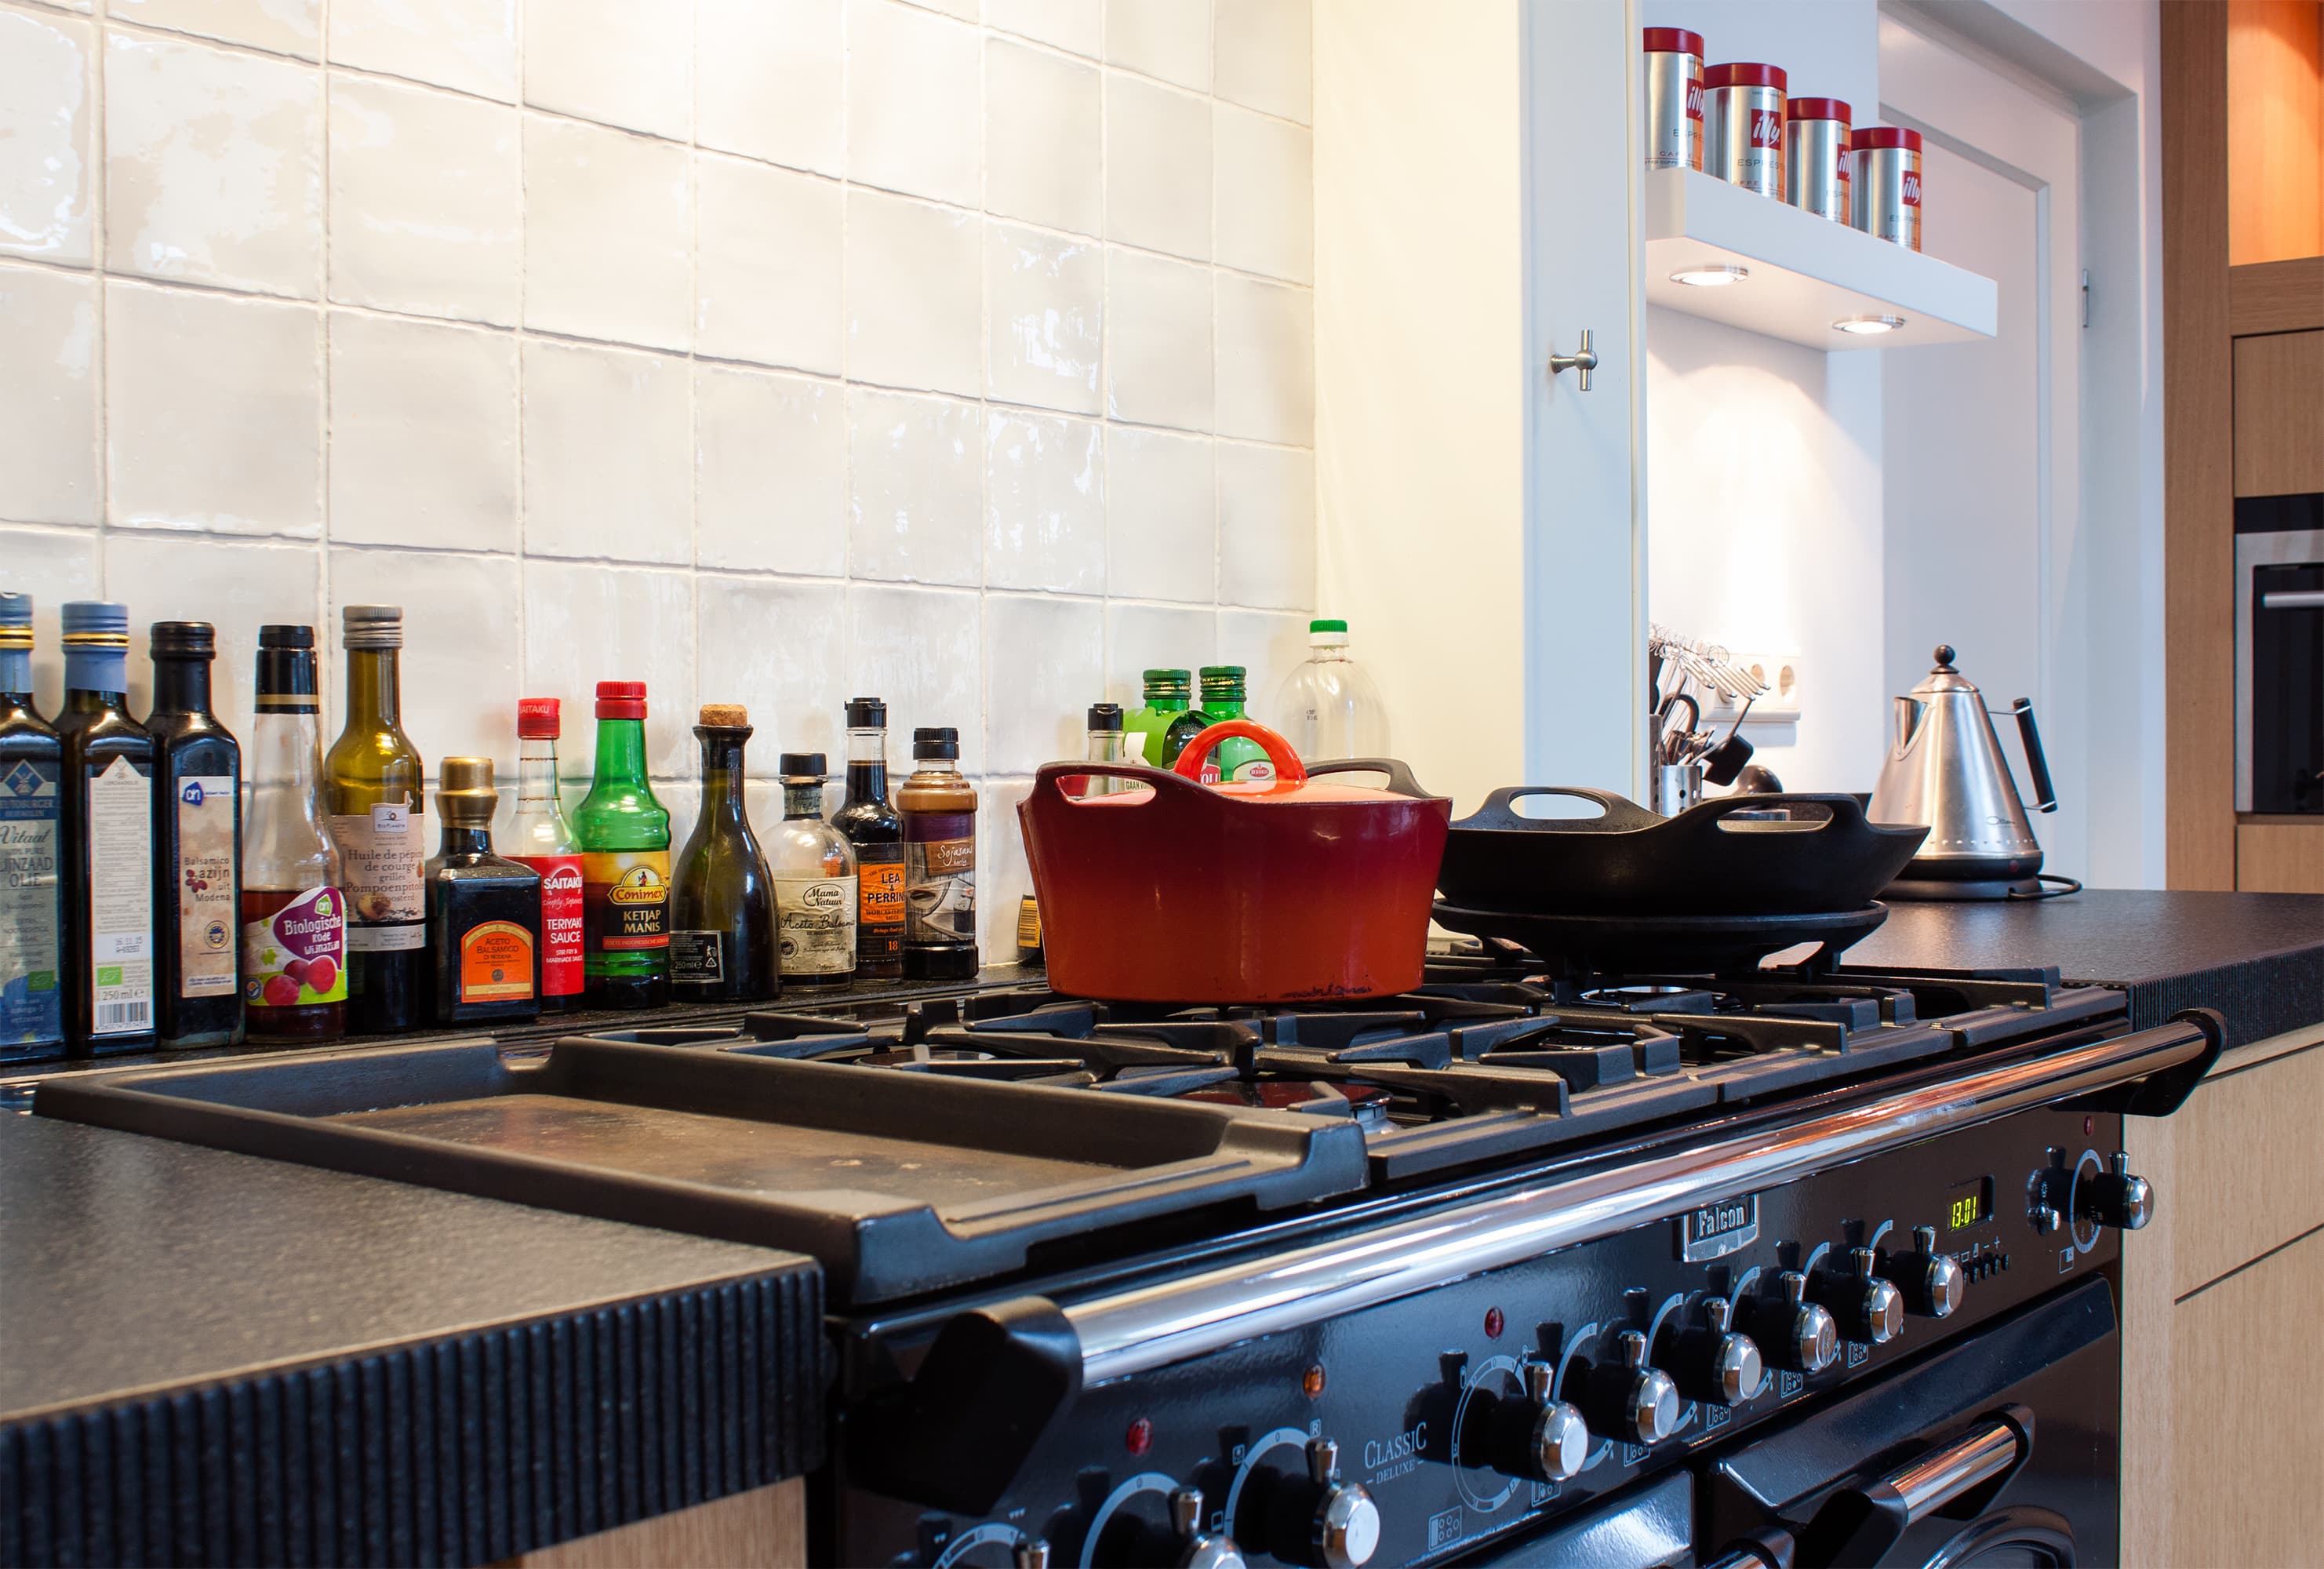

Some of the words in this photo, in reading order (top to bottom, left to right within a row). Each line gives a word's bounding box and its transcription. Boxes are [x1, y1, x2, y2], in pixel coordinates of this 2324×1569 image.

[1753, 115, 1780, 145] illy
[1902, 177, 1921, 205] illy
[1126, 781, 1140, 791] GAAN
[184, 857, 230, 866] Balsamico
[347, 849, 382, 861] Huile
[384, 849, 397, 860] de
[0, 856, 53, 874] IJNZAAD
[364, 861, 379, 872] de
[381, 862, 416, 874] courge
[9, 872, 42, 888] OLIE
[882, 872, 901, 884] LEA
[195, 892, 231, 903] Modena
[616, 888, 664, 901] Conimex
[808, 888, 839, 898] Mama
[815, 897, 842, 907] Natuur
[623, 909, 662, 923] KETJAP
[781, 912, 813, 930] Aceto
[283, 912, 342, 936] Biologische
[624, 921, 661, 934] MANIS
[550, 930, 581, 945] SAUCE
[476, 945, 519, 954] BALSAMICO
[888, 940, 898, 952] 18
[102, 990, 118, 1001] 250
[120, 988, 133, 999] ml
[1951, 1196, 1977, 1229] 13.01
[1698, 1206, 1745, 1237] Falcon
[1364, 1421, 1427, 1469] CLASSIC
[1376, 1459, 1416, 1485] DELUXE
